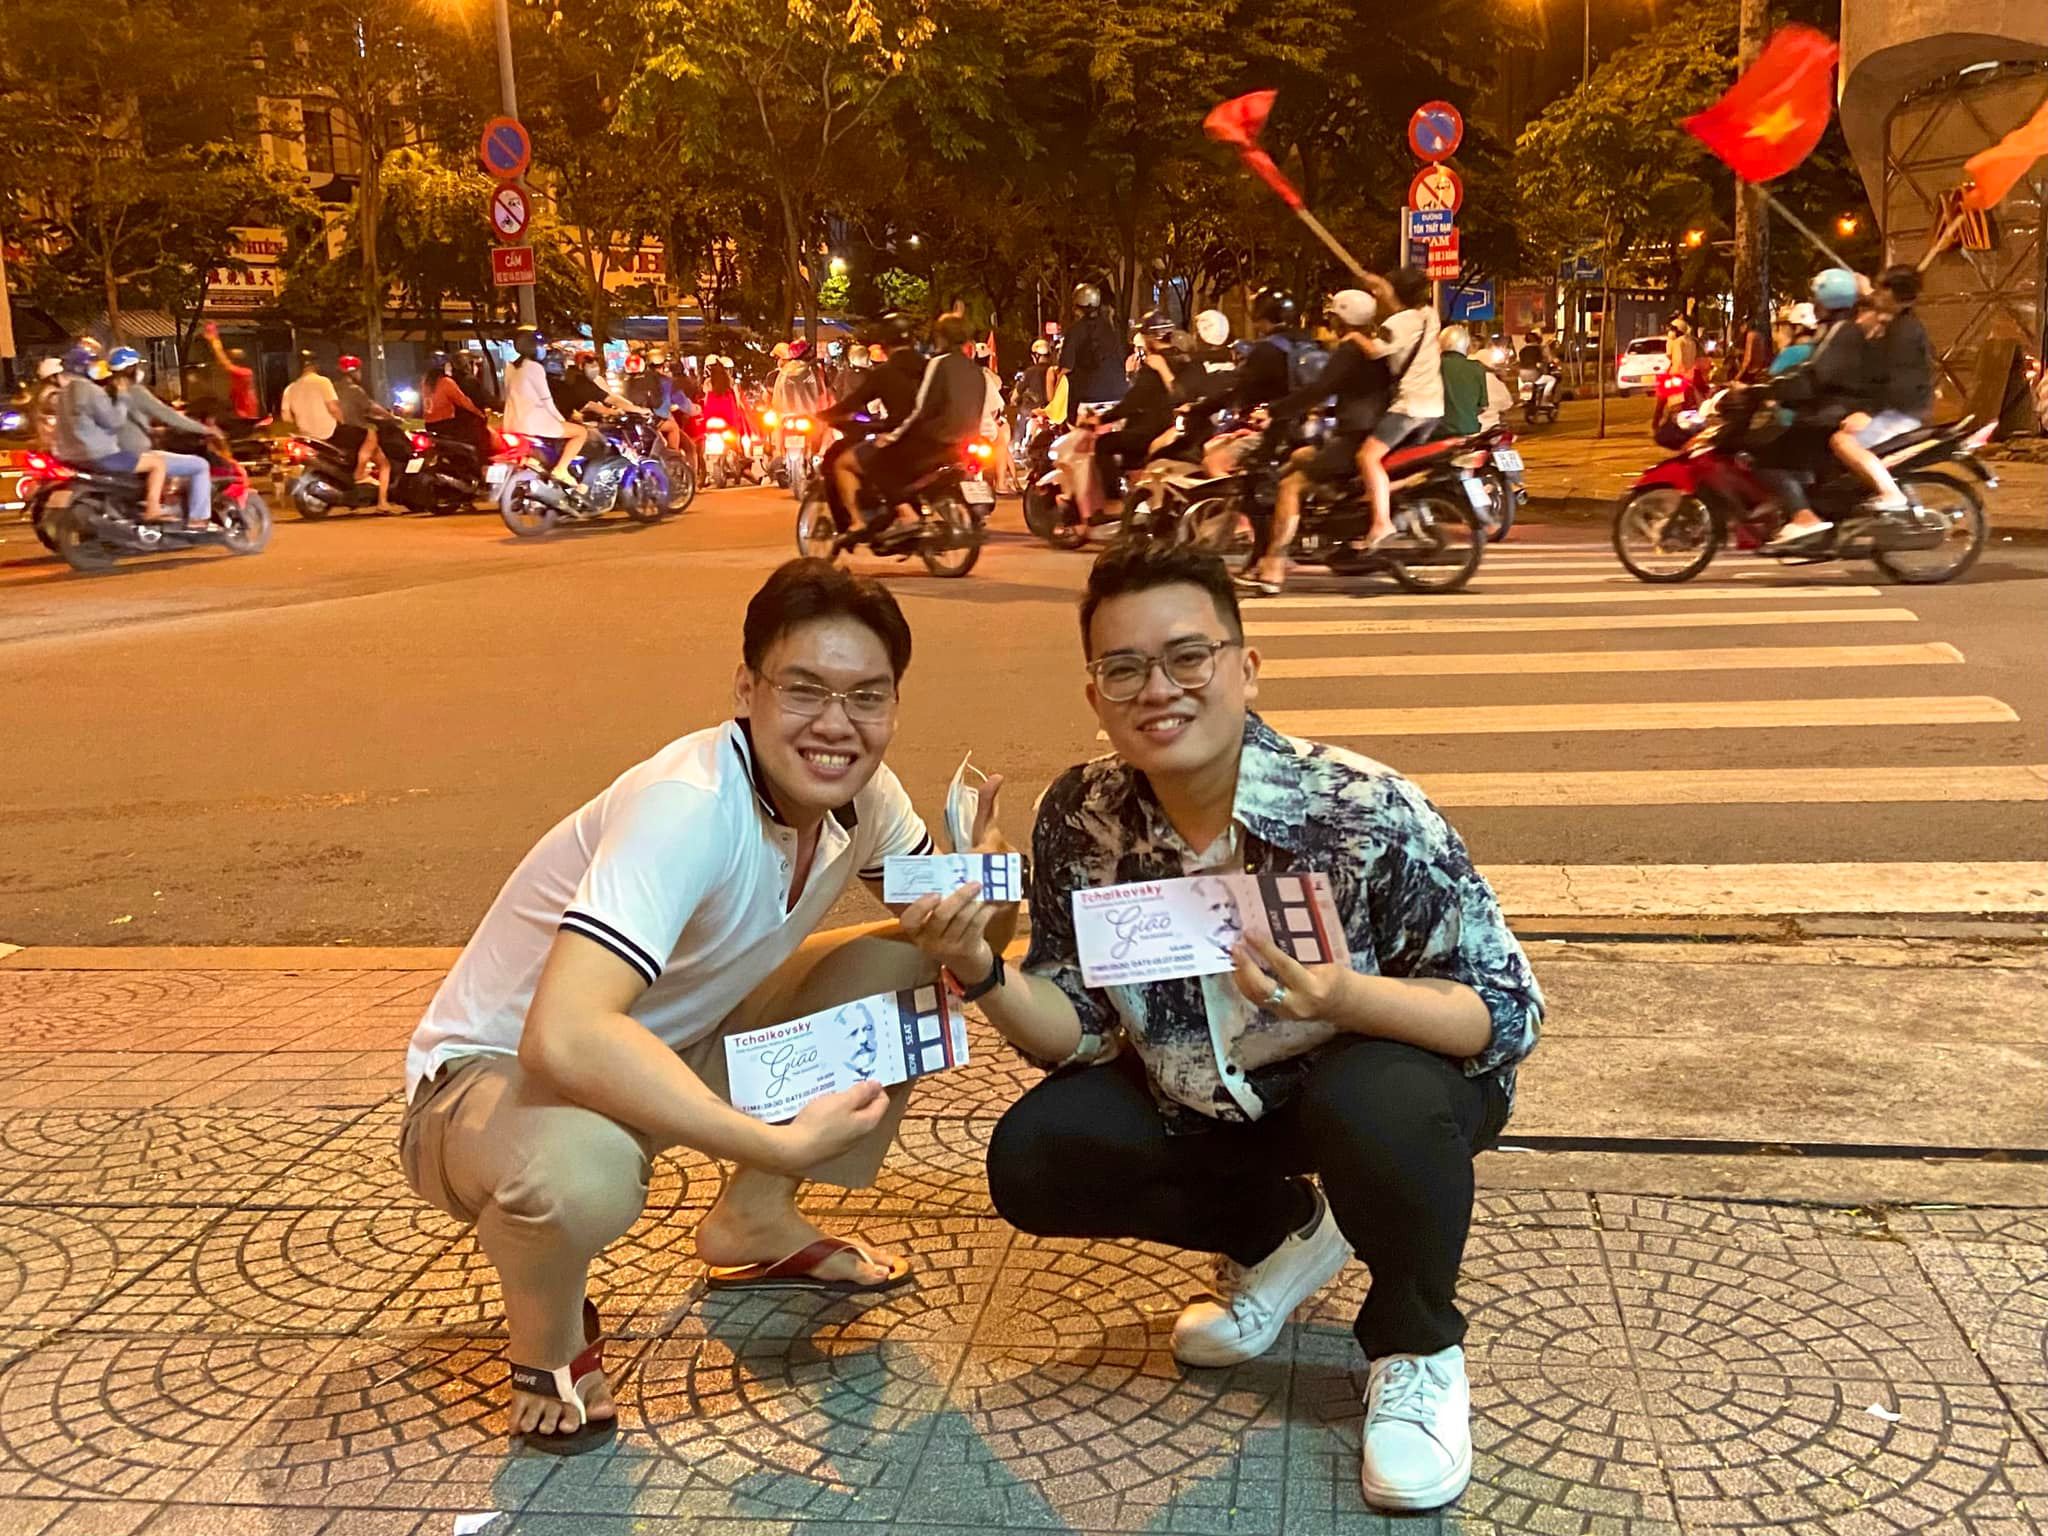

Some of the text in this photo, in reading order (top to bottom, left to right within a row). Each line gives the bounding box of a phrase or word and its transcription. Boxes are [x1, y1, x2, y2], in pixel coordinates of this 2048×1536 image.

[1081, 883, 1162, 903] Tchaikovsky
[735, 1021, 812, 1047] Tchaikovsky
[903, 1023, 914, 1046] SEAT
